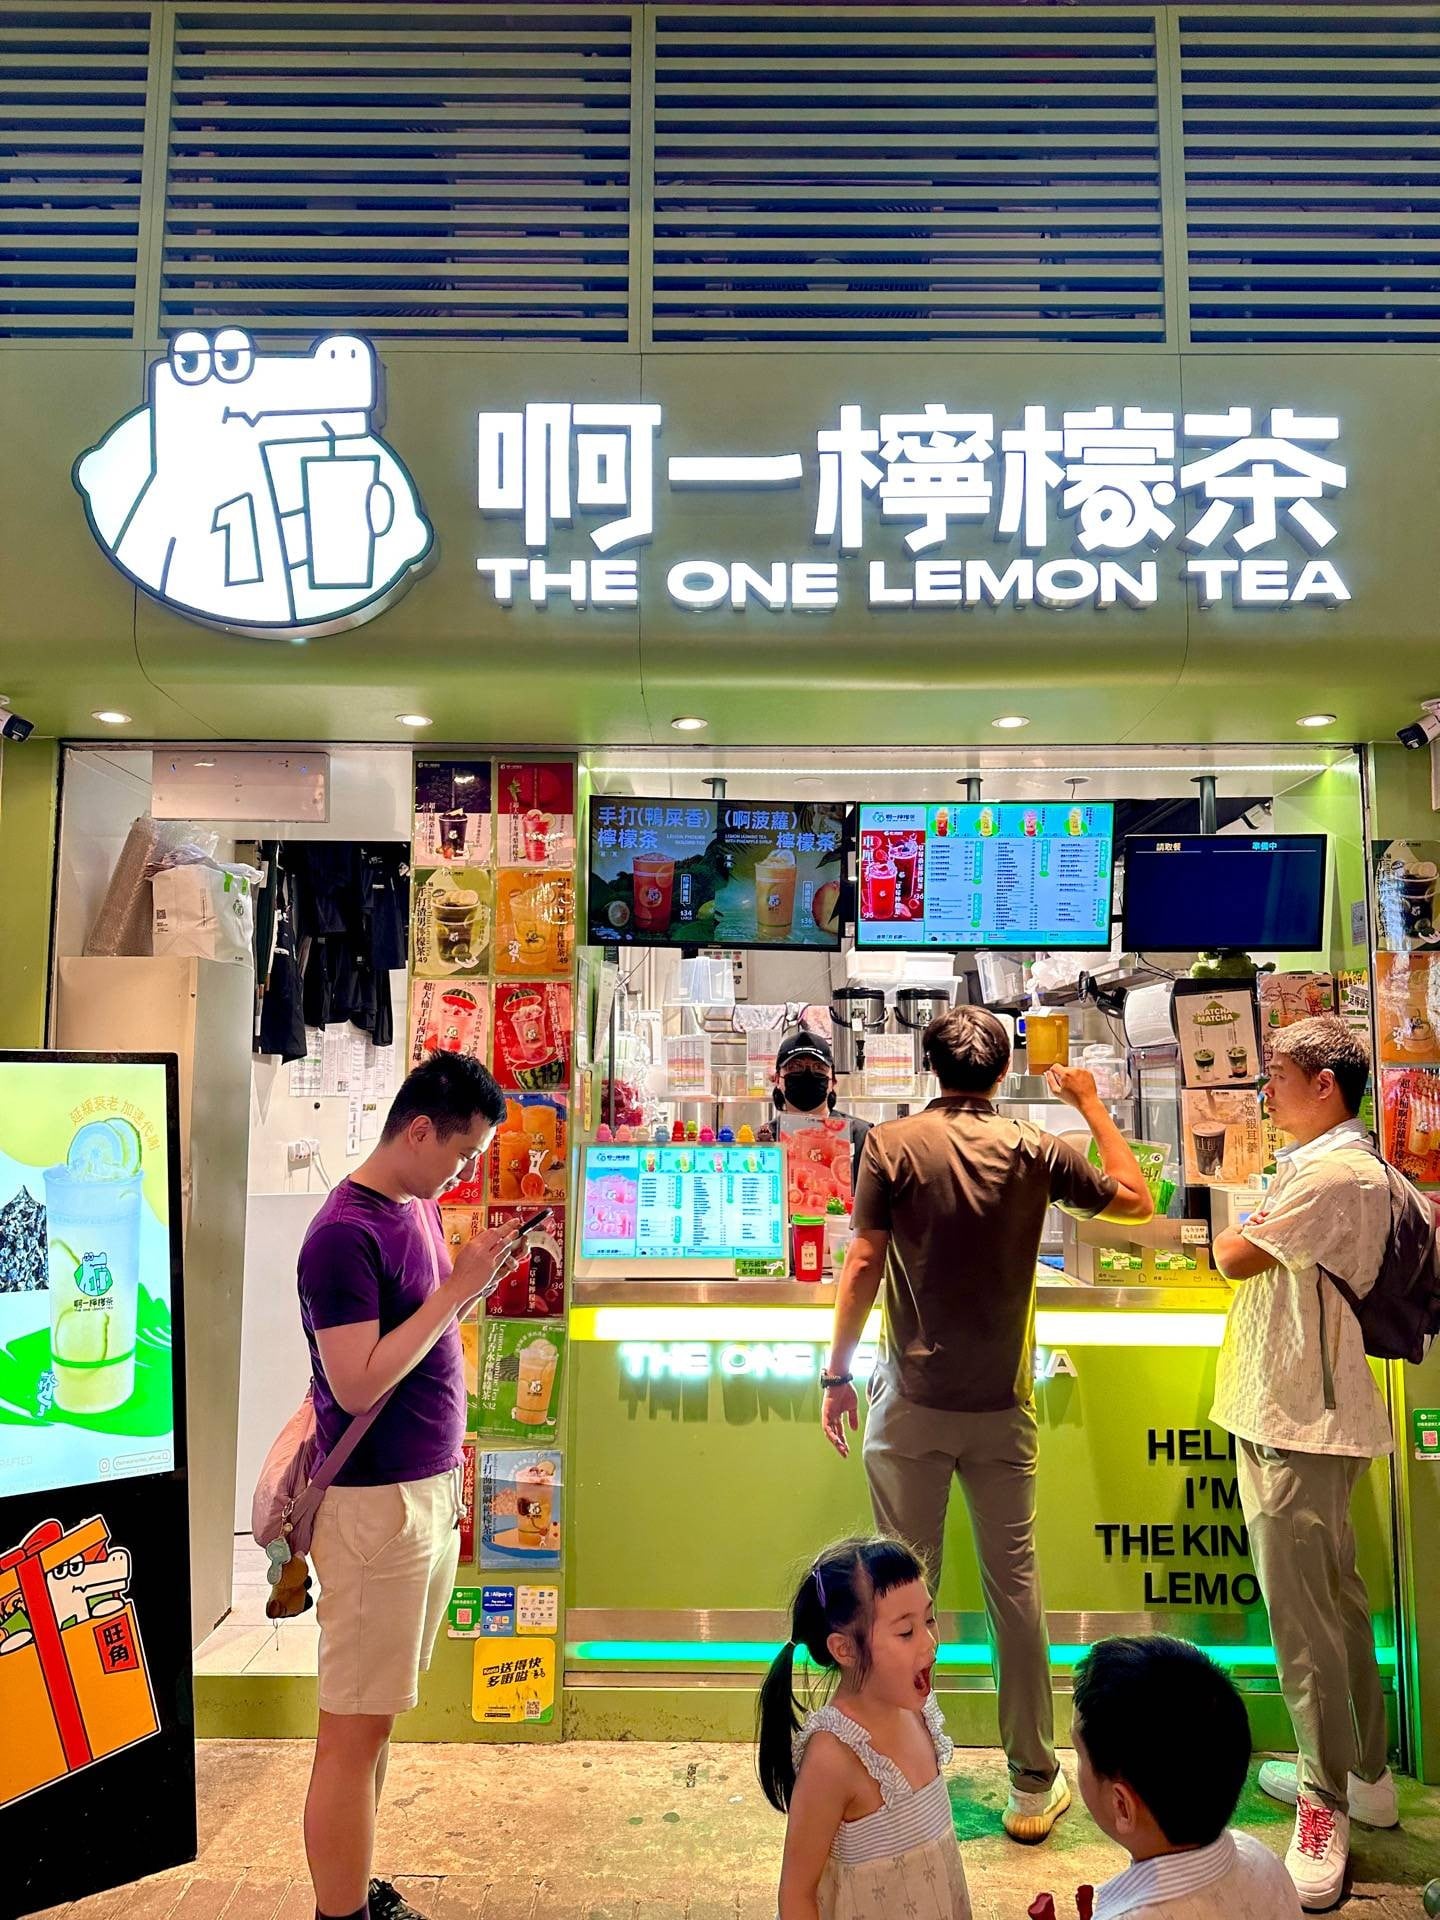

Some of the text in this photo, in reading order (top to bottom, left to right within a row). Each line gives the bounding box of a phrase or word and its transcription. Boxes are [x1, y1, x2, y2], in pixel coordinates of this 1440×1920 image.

[478, 403, 1347, 553] 啊一檸檬茶
[476, 558, 1352, 607] THE ONE LEMON TEA
[597, 827, 658, 850] 檸檬茶
[776, 831, 836, 852] 檸檬茶
[412, 982, 433, 1061] 超大桶手打西瓜檸檬
[1197, 1013, 1233, 1023] MATCHA
[620, 1341, 710, 1377] THE
[720, 1341, 814, 1377] ONE
[1148, 1428, 1237, 1462] HELL
[1186, 1475, 1242, 1510] I'M
[1094, 1523, 1249, 1557] THE KIN
[1144, 1571, 1262, 1606] LEMO
[102, 1622, 130, 1669] 旺角
[500, 1657, 542, 1673] 送得快
